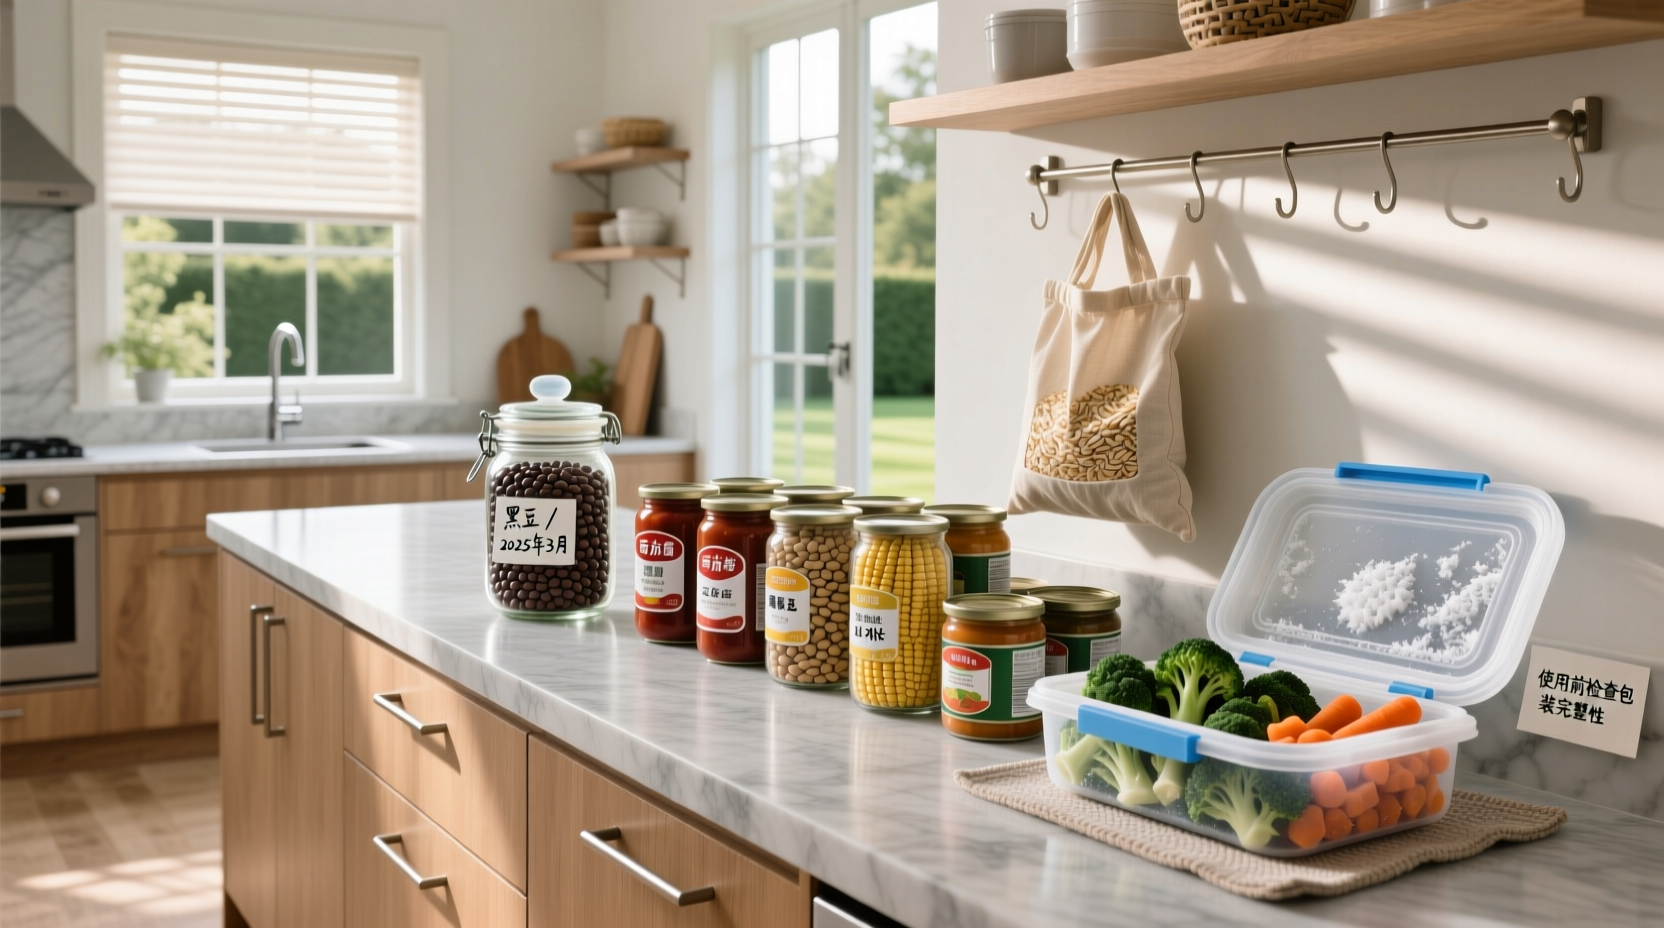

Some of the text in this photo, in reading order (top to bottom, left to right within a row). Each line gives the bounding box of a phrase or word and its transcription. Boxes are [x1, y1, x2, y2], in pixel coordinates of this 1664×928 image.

[500, 533, 567, 557] 2025年3月
[1538, 668, 1634, 705] 使用前检查包
